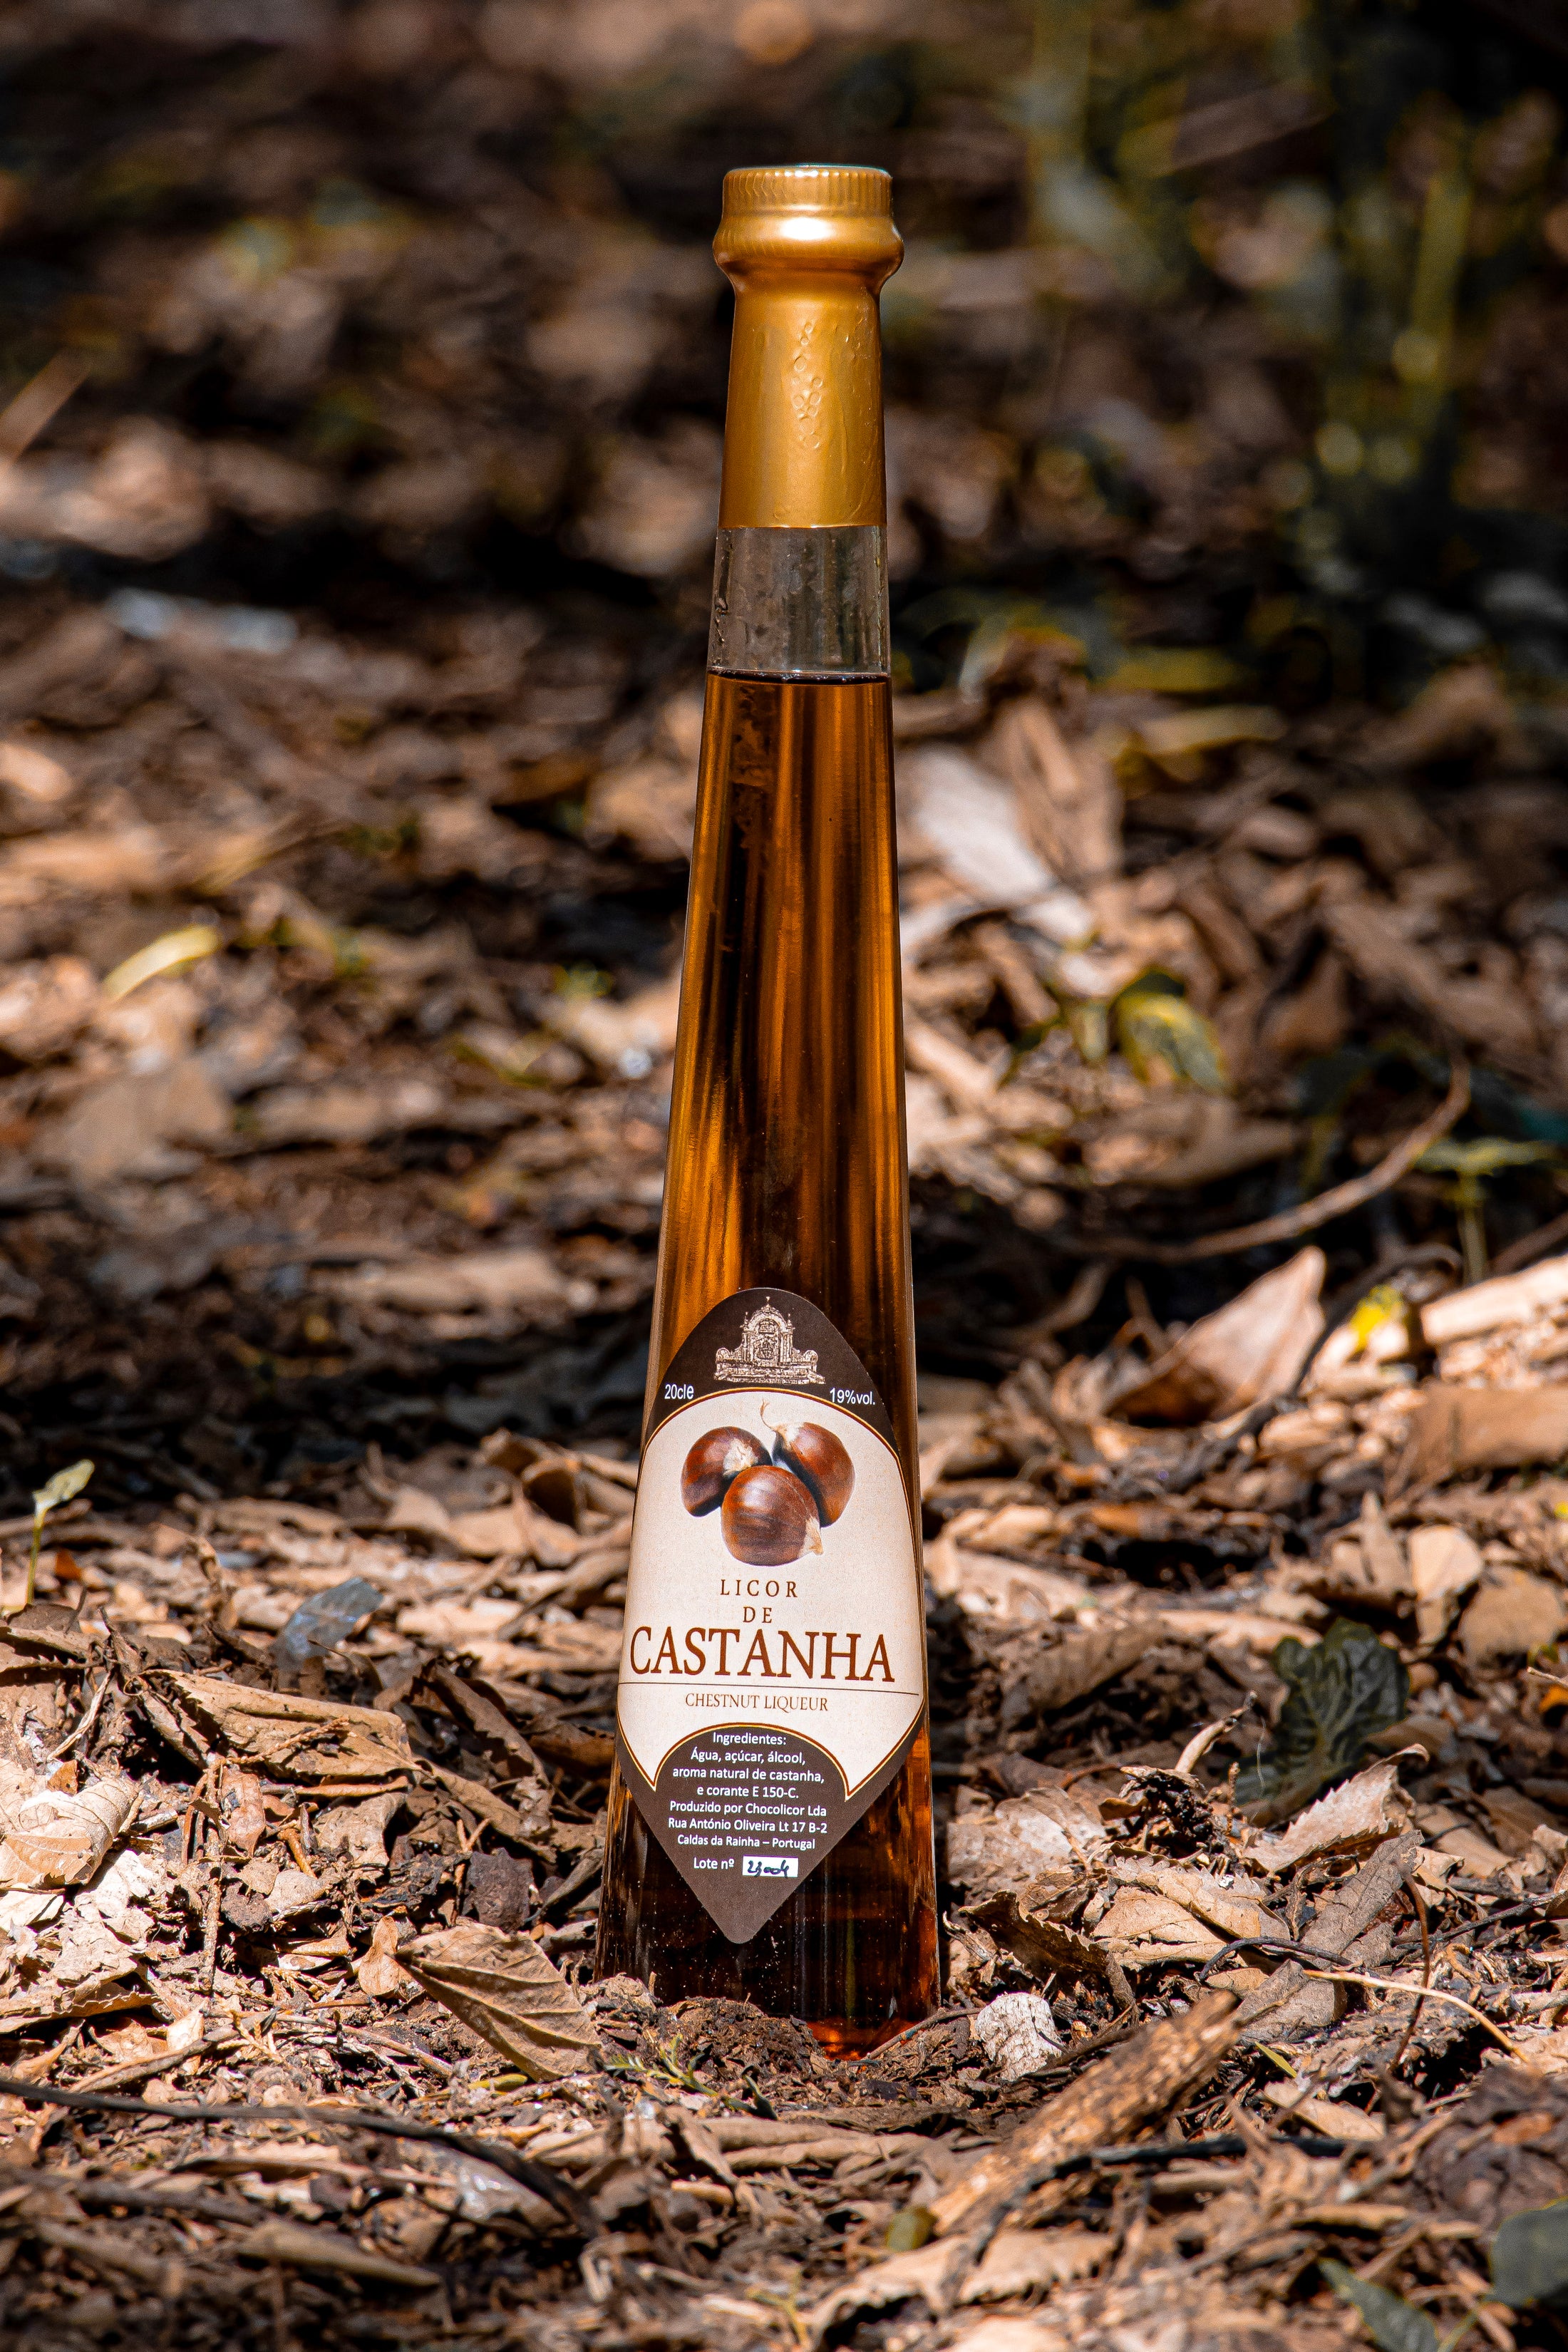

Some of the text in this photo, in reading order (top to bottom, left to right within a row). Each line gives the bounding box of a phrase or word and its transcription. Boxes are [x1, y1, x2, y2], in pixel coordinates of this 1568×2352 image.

[829, 1388, 875, 1405] 19%vol.
[720, 1579, 798, 1597] LICOR
[743, 1607, 772, 1623] DE
[630, 1626, 894, 1682] CASTANHA
[686, 1693, 828, 1713] CHESTNUT LIQUEUR
[713, 1732, 786, 1745] Ingredientes:
[691, 1747, 805, 1765] Água, açúcar, álcool,
[673, 1768, 825, 1783] aroma natural de castanha,
[697, 1786, 799, 1798] e corante E 150-C.
[670, 1801, 827, 1816] Produzido por Chocolicor Lda
[668, 1818, 827, 1833] Rua António Oliveira Lt 17 B-2
[678, 1835, 708, 1845] Caldas
[711, 1835, 723, 1846] da
[726, 1836, 760, 1847] Rainha
[773, 1838, 815, 1851] Portugal
[693, 1857, 718, 1869] Lote
